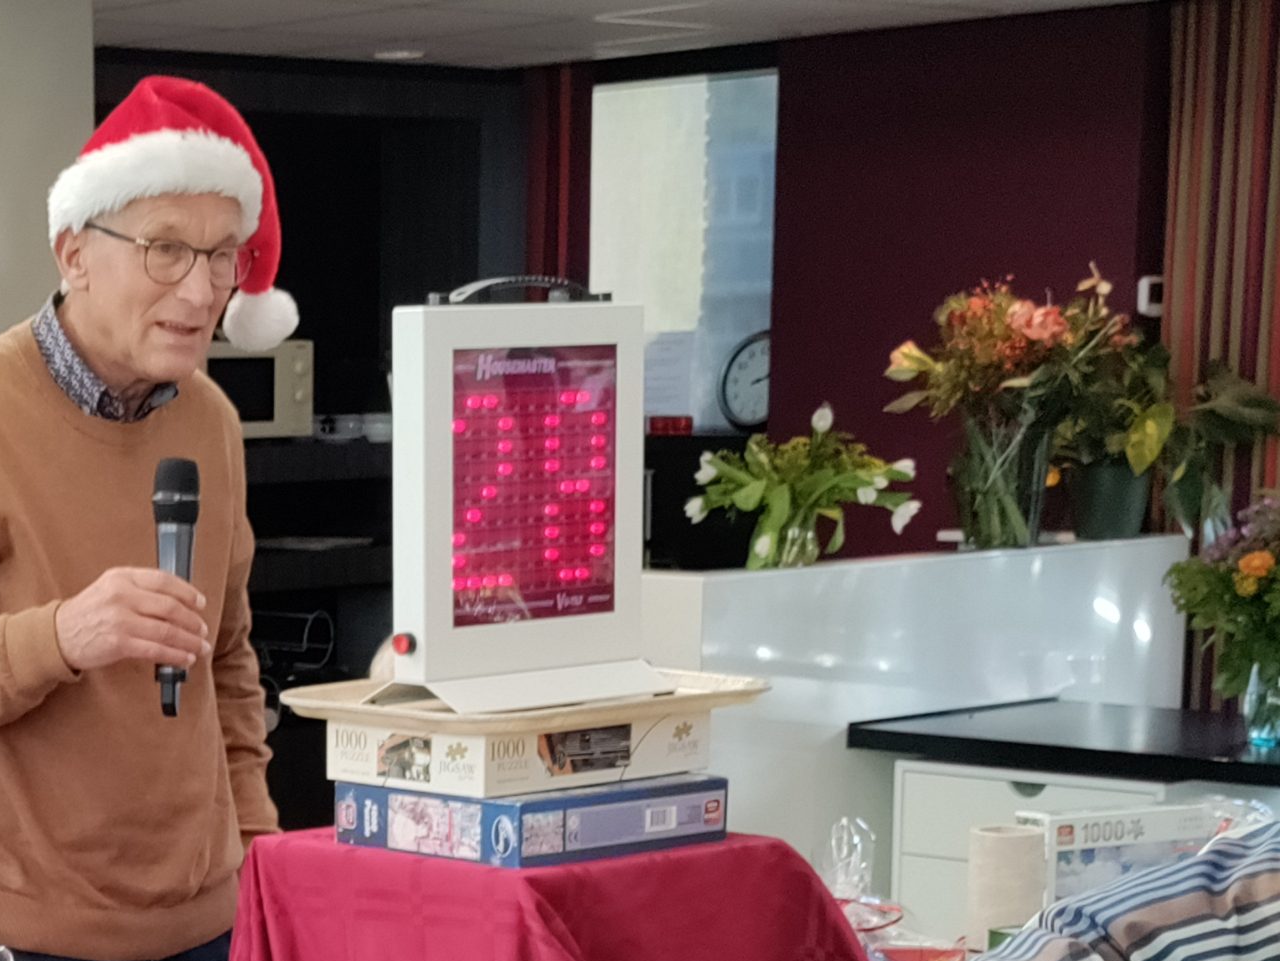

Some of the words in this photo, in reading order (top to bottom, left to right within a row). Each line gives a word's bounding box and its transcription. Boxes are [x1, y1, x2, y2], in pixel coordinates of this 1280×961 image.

[335, 728, 367, 750] 1000
[490, 738, 525, 761] 1000
[1080, 820, 1125, 844] 1000
